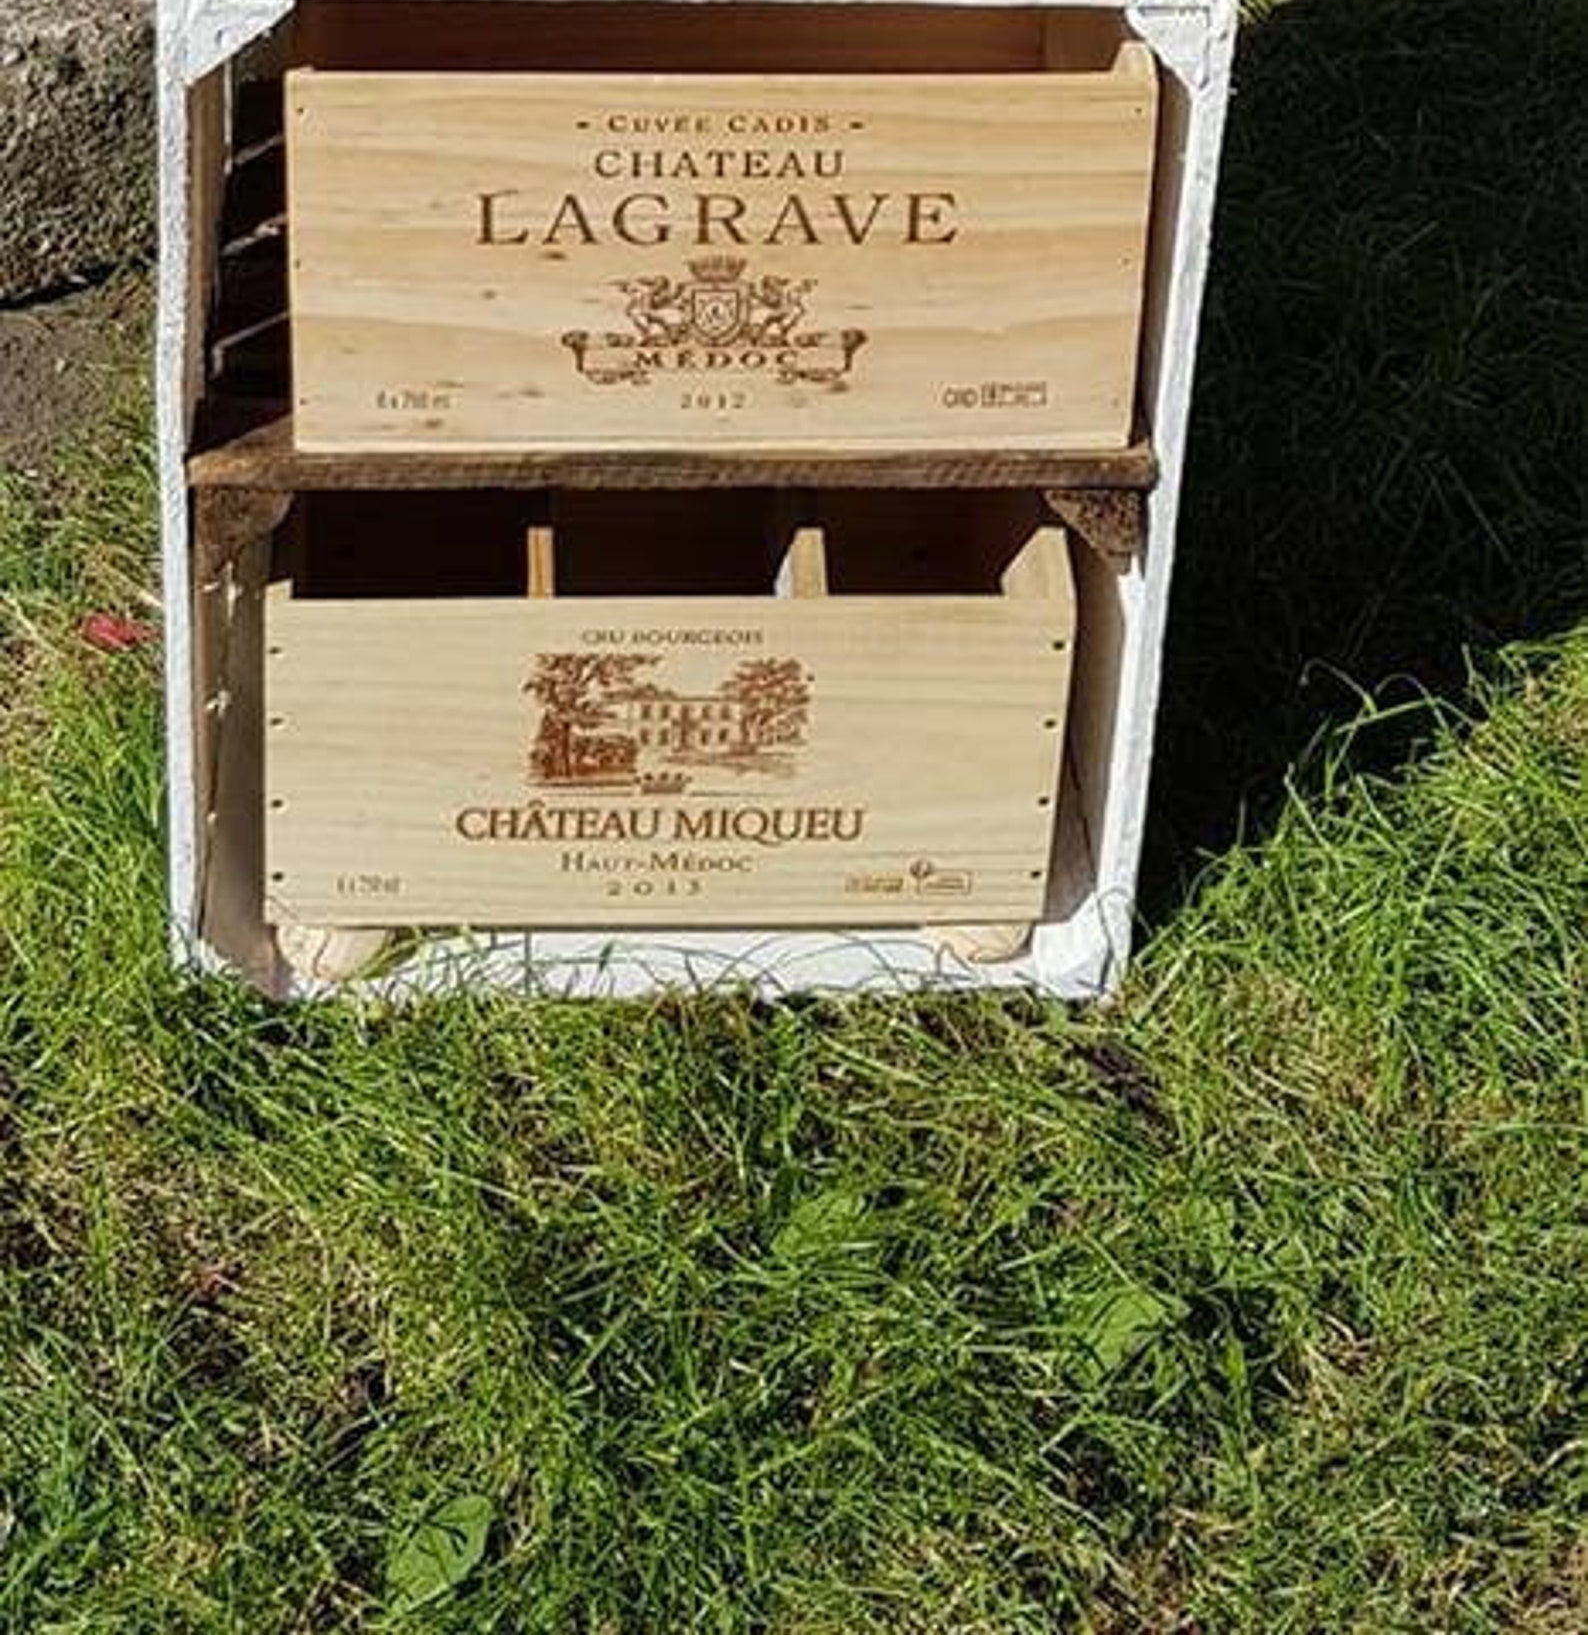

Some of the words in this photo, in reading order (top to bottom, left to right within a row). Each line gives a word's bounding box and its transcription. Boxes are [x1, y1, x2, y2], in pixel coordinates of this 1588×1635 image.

[607, 114, 704, 133] CUVÉE
[728, 115, 830, 133] CADIS
[595, 151, 842, 178] CHATEAU
[477, 194, 956, 245] LAGRAVE
[634, 349, 798, 369] MÉDOC
[681, 393, 745, 409] 2012
[456, 800, 660, 840] CHÂTEAU
[674, 808, 864, 846] MIQUEU
